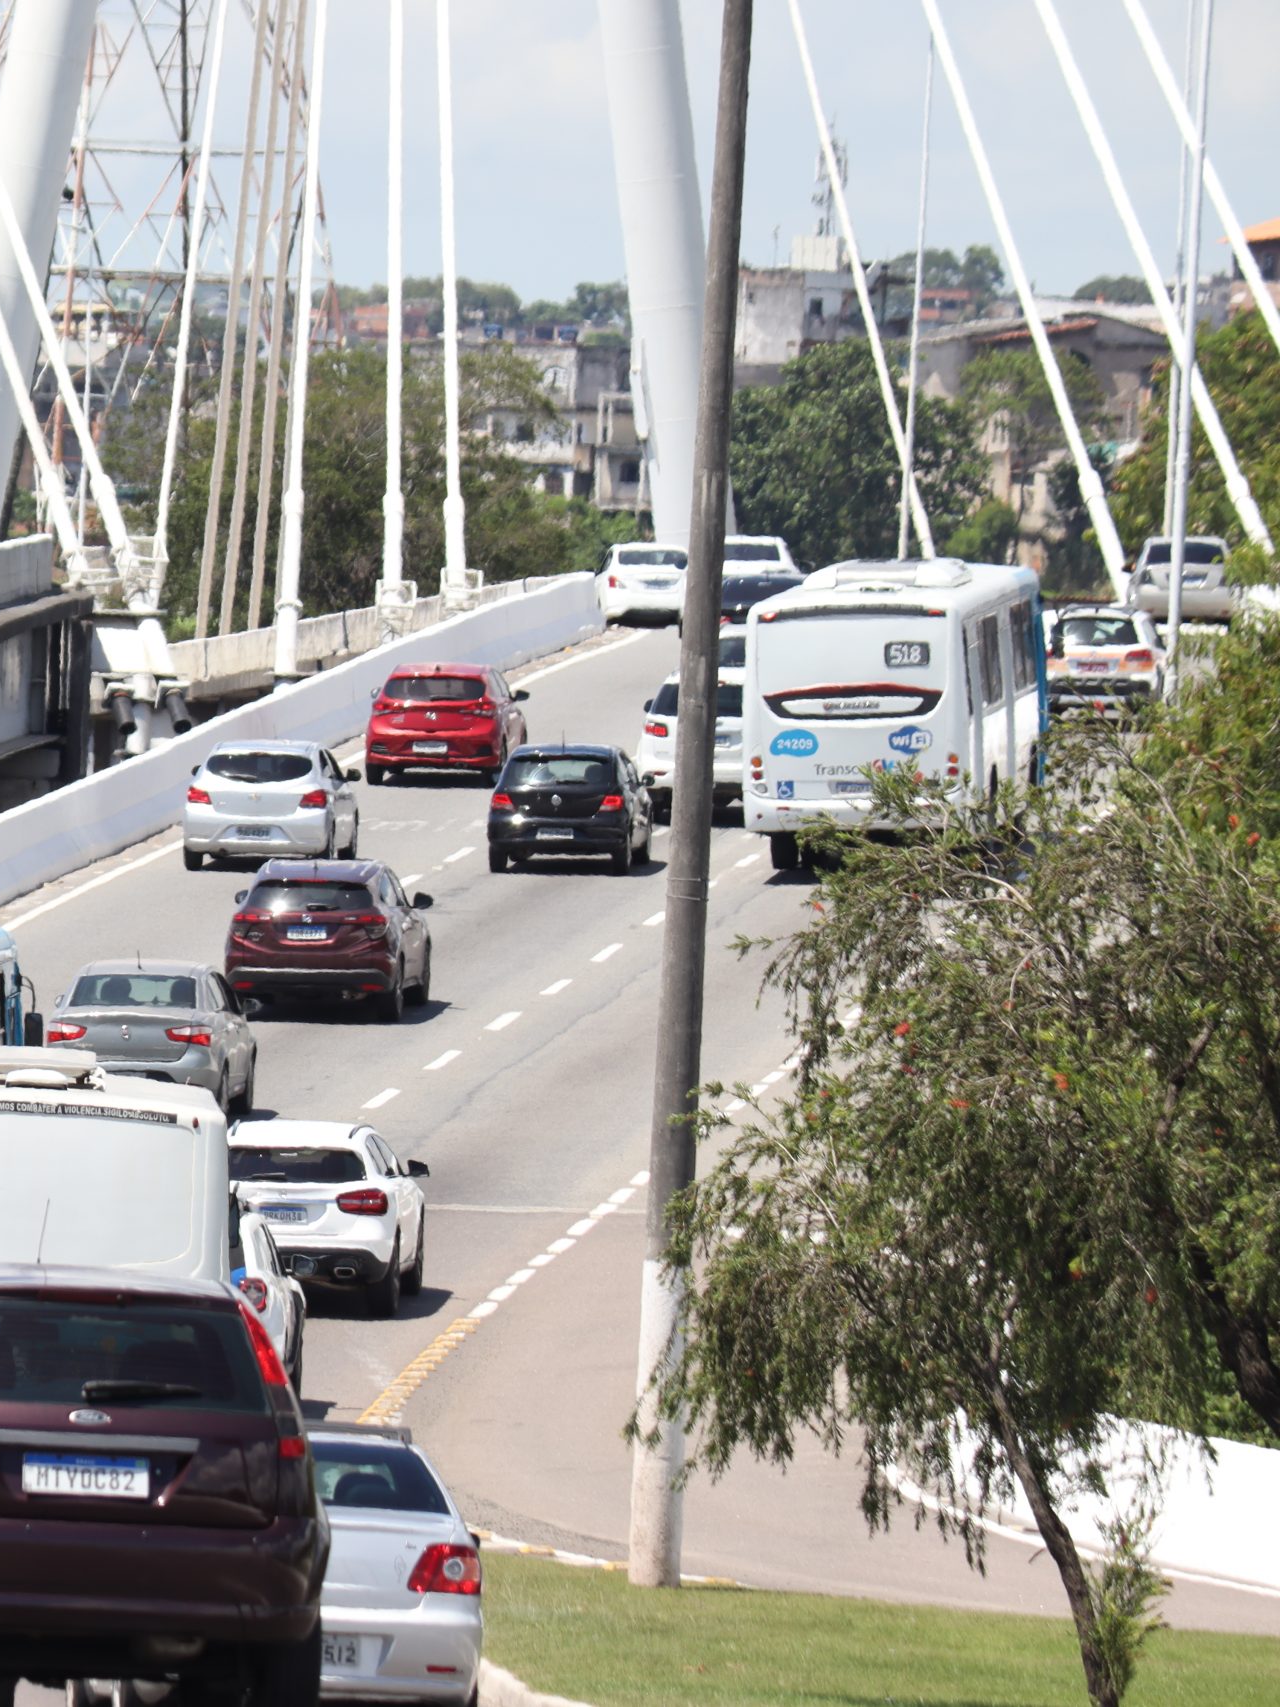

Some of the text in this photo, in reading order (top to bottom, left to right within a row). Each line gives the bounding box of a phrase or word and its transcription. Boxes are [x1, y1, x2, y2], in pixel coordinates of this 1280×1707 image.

[889, 645, 921, 664] 518
[776, 738, 813, 750] 24209
[16, 1103, 55, 1114] COMBATER
